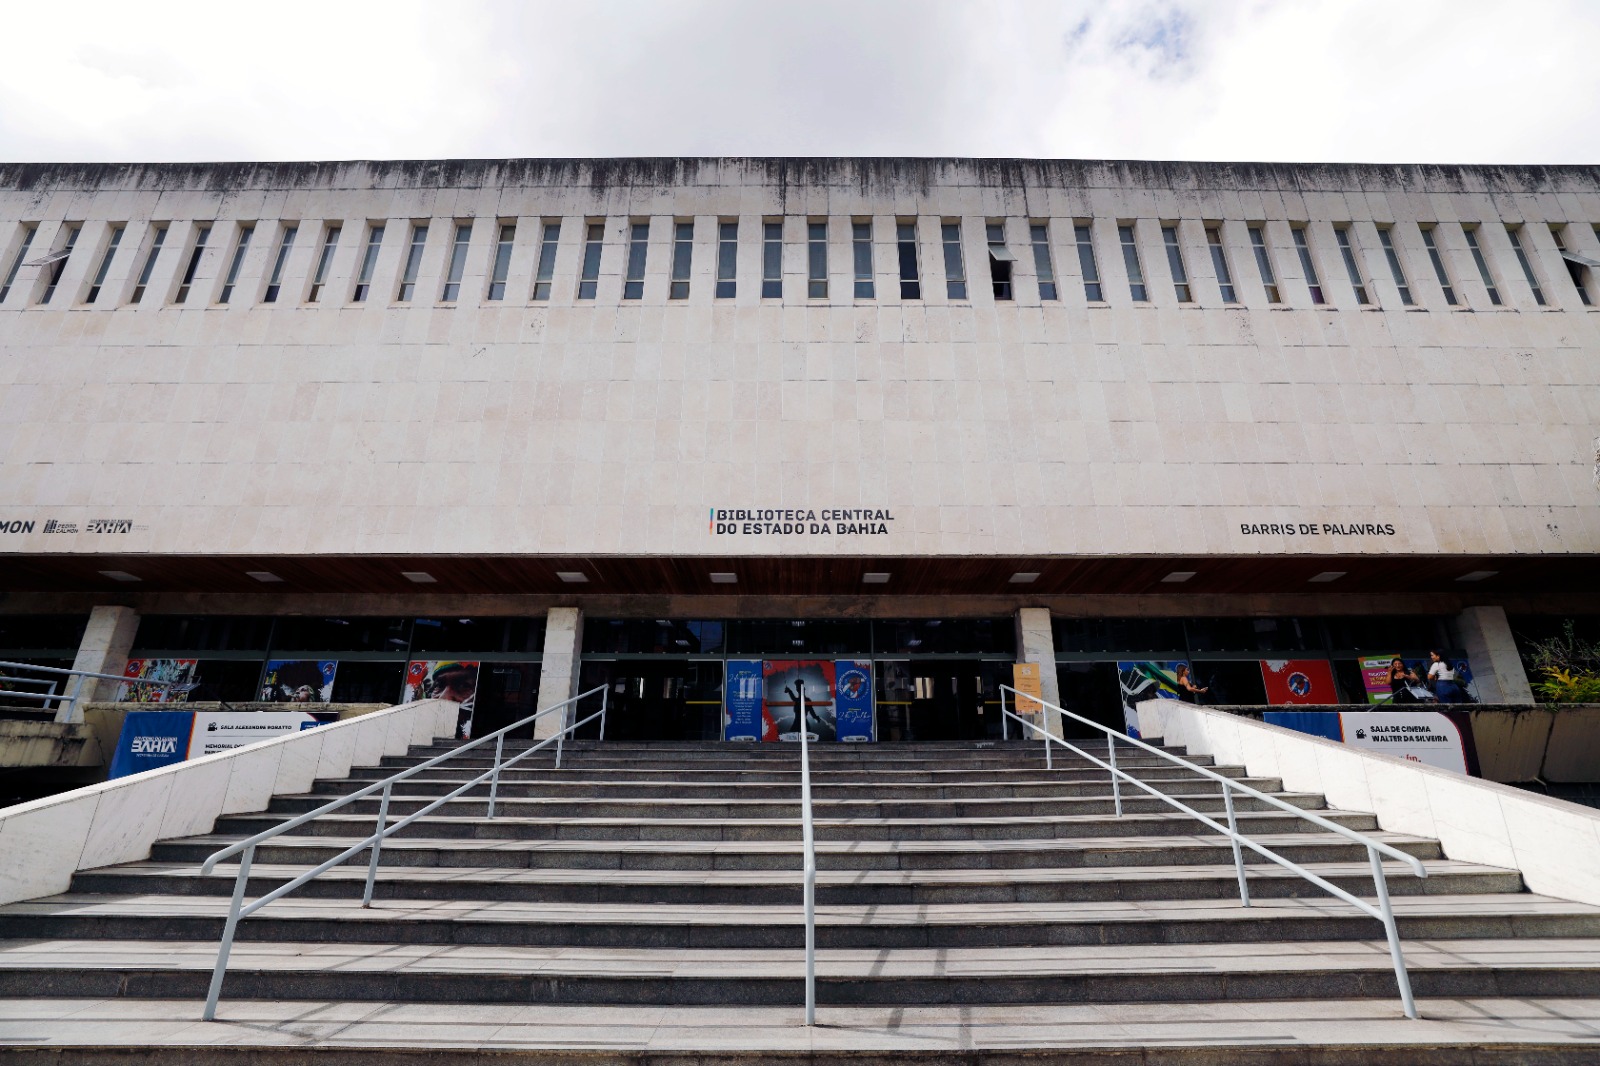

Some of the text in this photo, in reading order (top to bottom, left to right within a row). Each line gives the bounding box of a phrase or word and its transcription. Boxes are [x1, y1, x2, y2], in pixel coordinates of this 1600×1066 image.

[716, 509, 894, 521] BIBLIOTECA CENTRAL
[716, 522, 888, 535] DO ESTADO DA BAHIA
[1240, 523, 1396, 536] BARRIS DE PALAVRAS
[1370, 725, 1431, 733] SALA DE CINEMA
